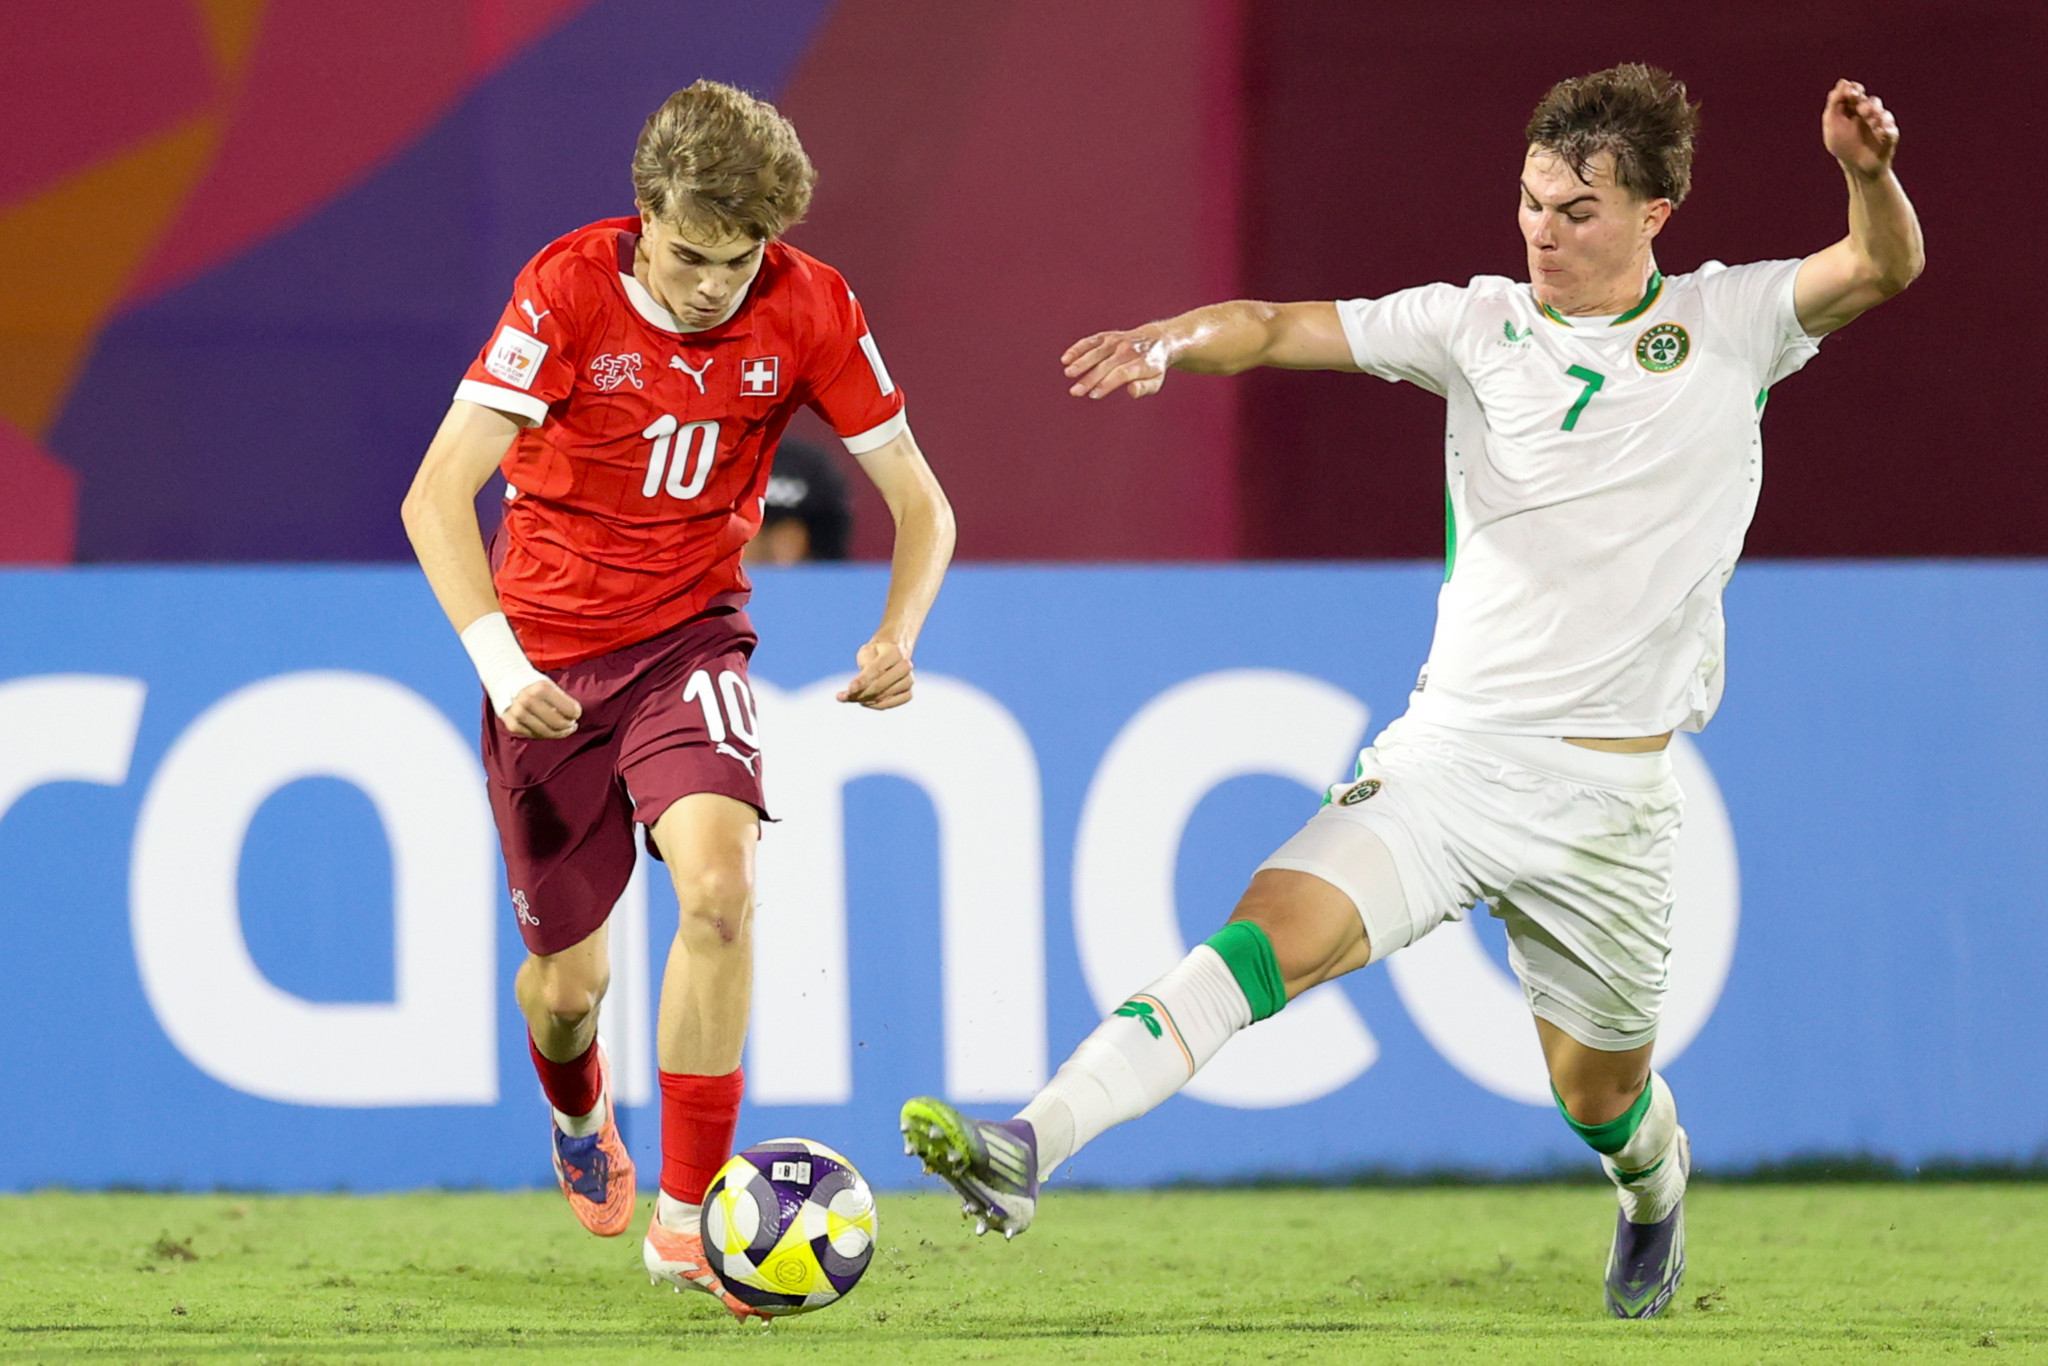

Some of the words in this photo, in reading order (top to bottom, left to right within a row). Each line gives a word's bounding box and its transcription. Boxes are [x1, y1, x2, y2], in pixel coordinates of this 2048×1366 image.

[1637, 325, 1679, 352] IRELAND
[1560, 364, 1606, 432] 7
[642, 413, 720, 500] 10
[682, 669, 760, 750] 10
